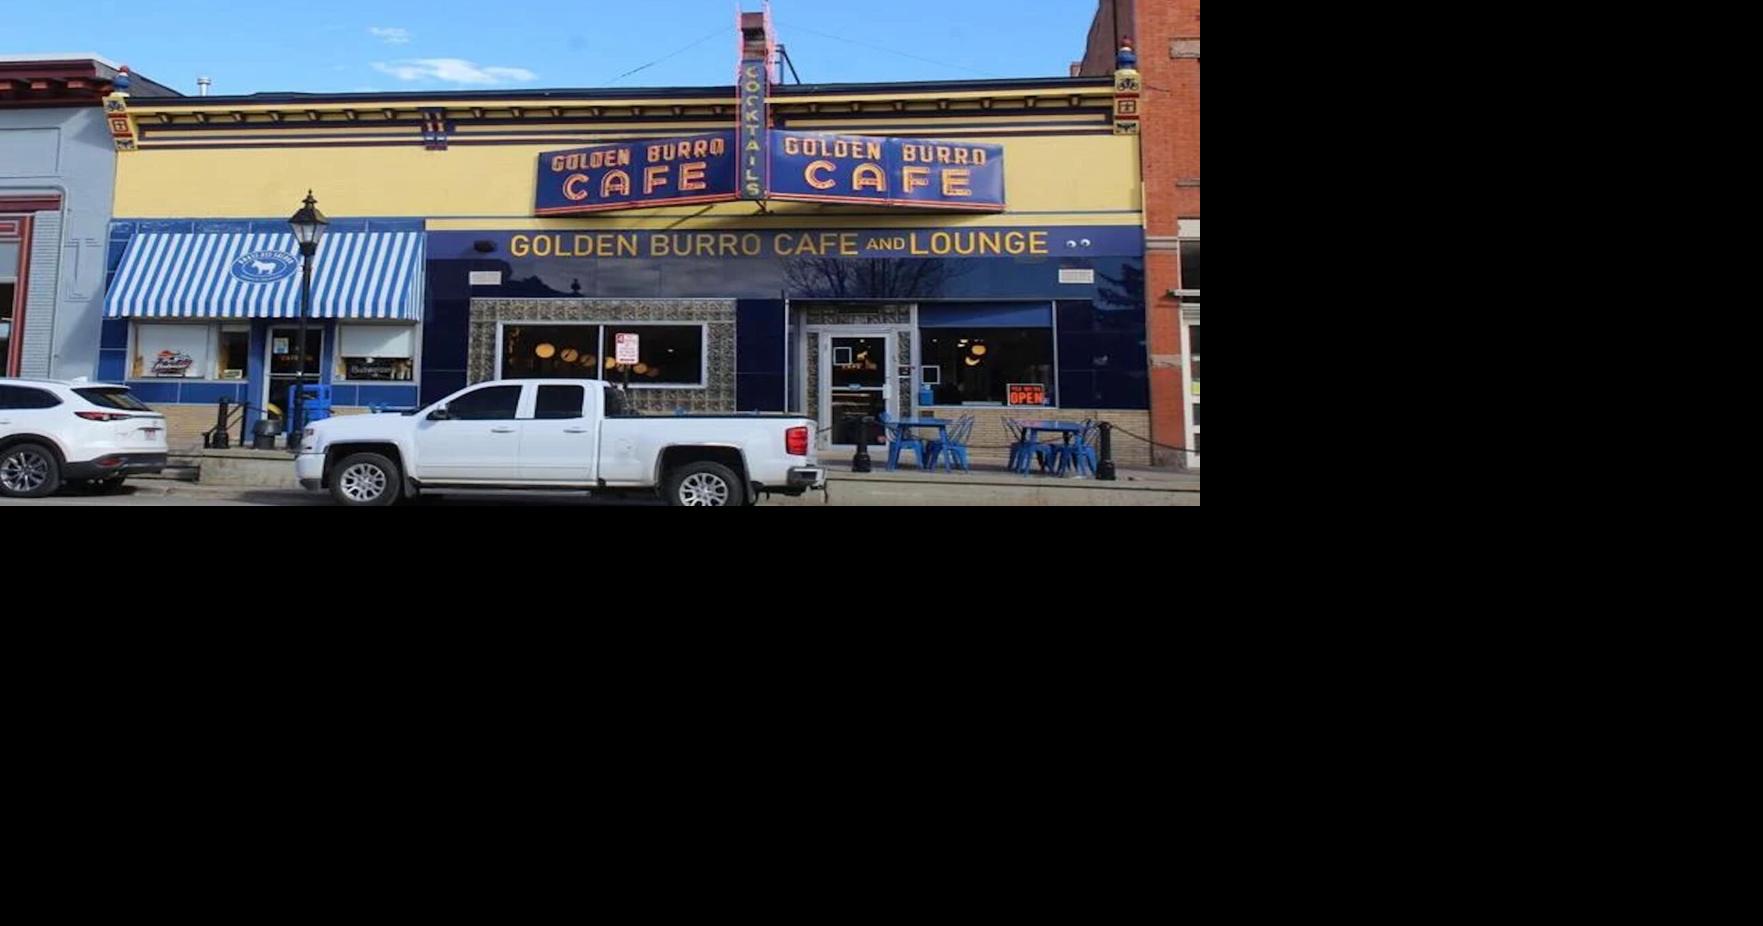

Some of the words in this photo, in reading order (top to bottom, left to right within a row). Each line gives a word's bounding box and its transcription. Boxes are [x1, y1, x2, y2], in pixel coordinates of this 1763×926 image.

[744, 66, 760, 196] COCKTAILS
[551, 148, 631, 172] GOLDEN
[647, 137, 725, 162] BURRO
[784, 136, 882, 161] GOLDEN
[902, 144, 988, 166] BURRO
[562, 161, 707, 200] CAFE
[804, 160, 972, 197] CAFE
[511, 233, 638, 257] GOLDEN
[651, 233, 761, 256] BURRO
[773, 233, 859, 255] CAFE
[865, 237, 905, 250] AND
[910, 231, 1049, 255] LOUNGE
[1010, 391, 1044, 404] OPEN
